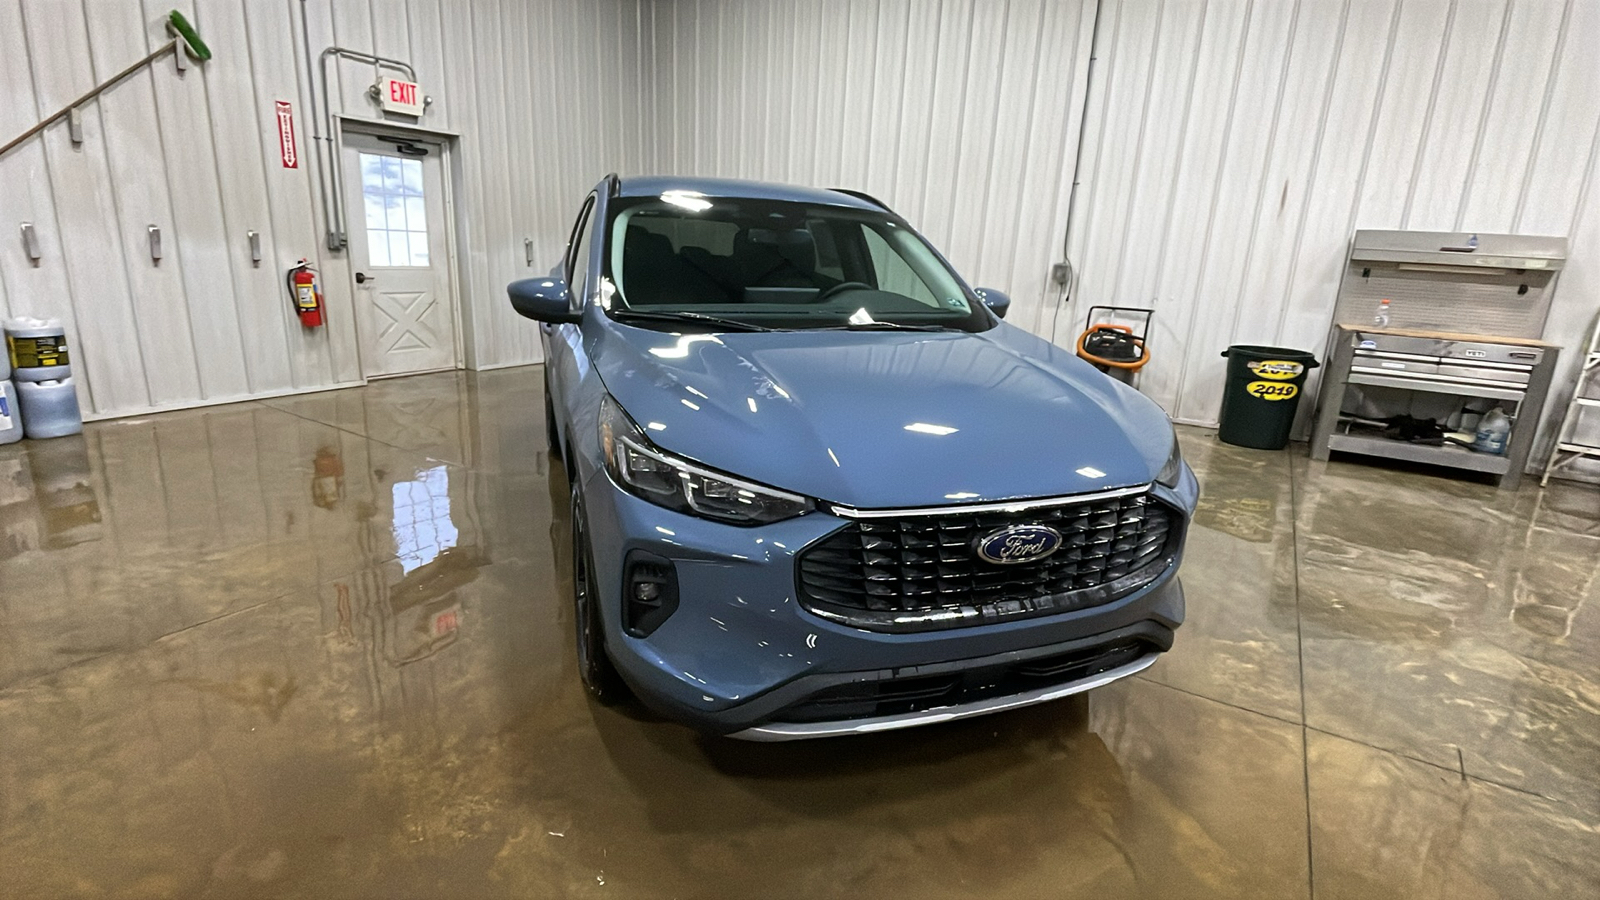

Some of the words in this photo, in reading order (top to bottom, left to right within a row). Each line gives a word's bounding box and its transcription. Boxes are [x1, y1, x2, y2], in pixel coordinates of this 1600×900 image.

[390, 80, 417, 106] EXIT
[1253, 384, 1294, 396] 2019
[1000, 533, 1046, 558] Ford
